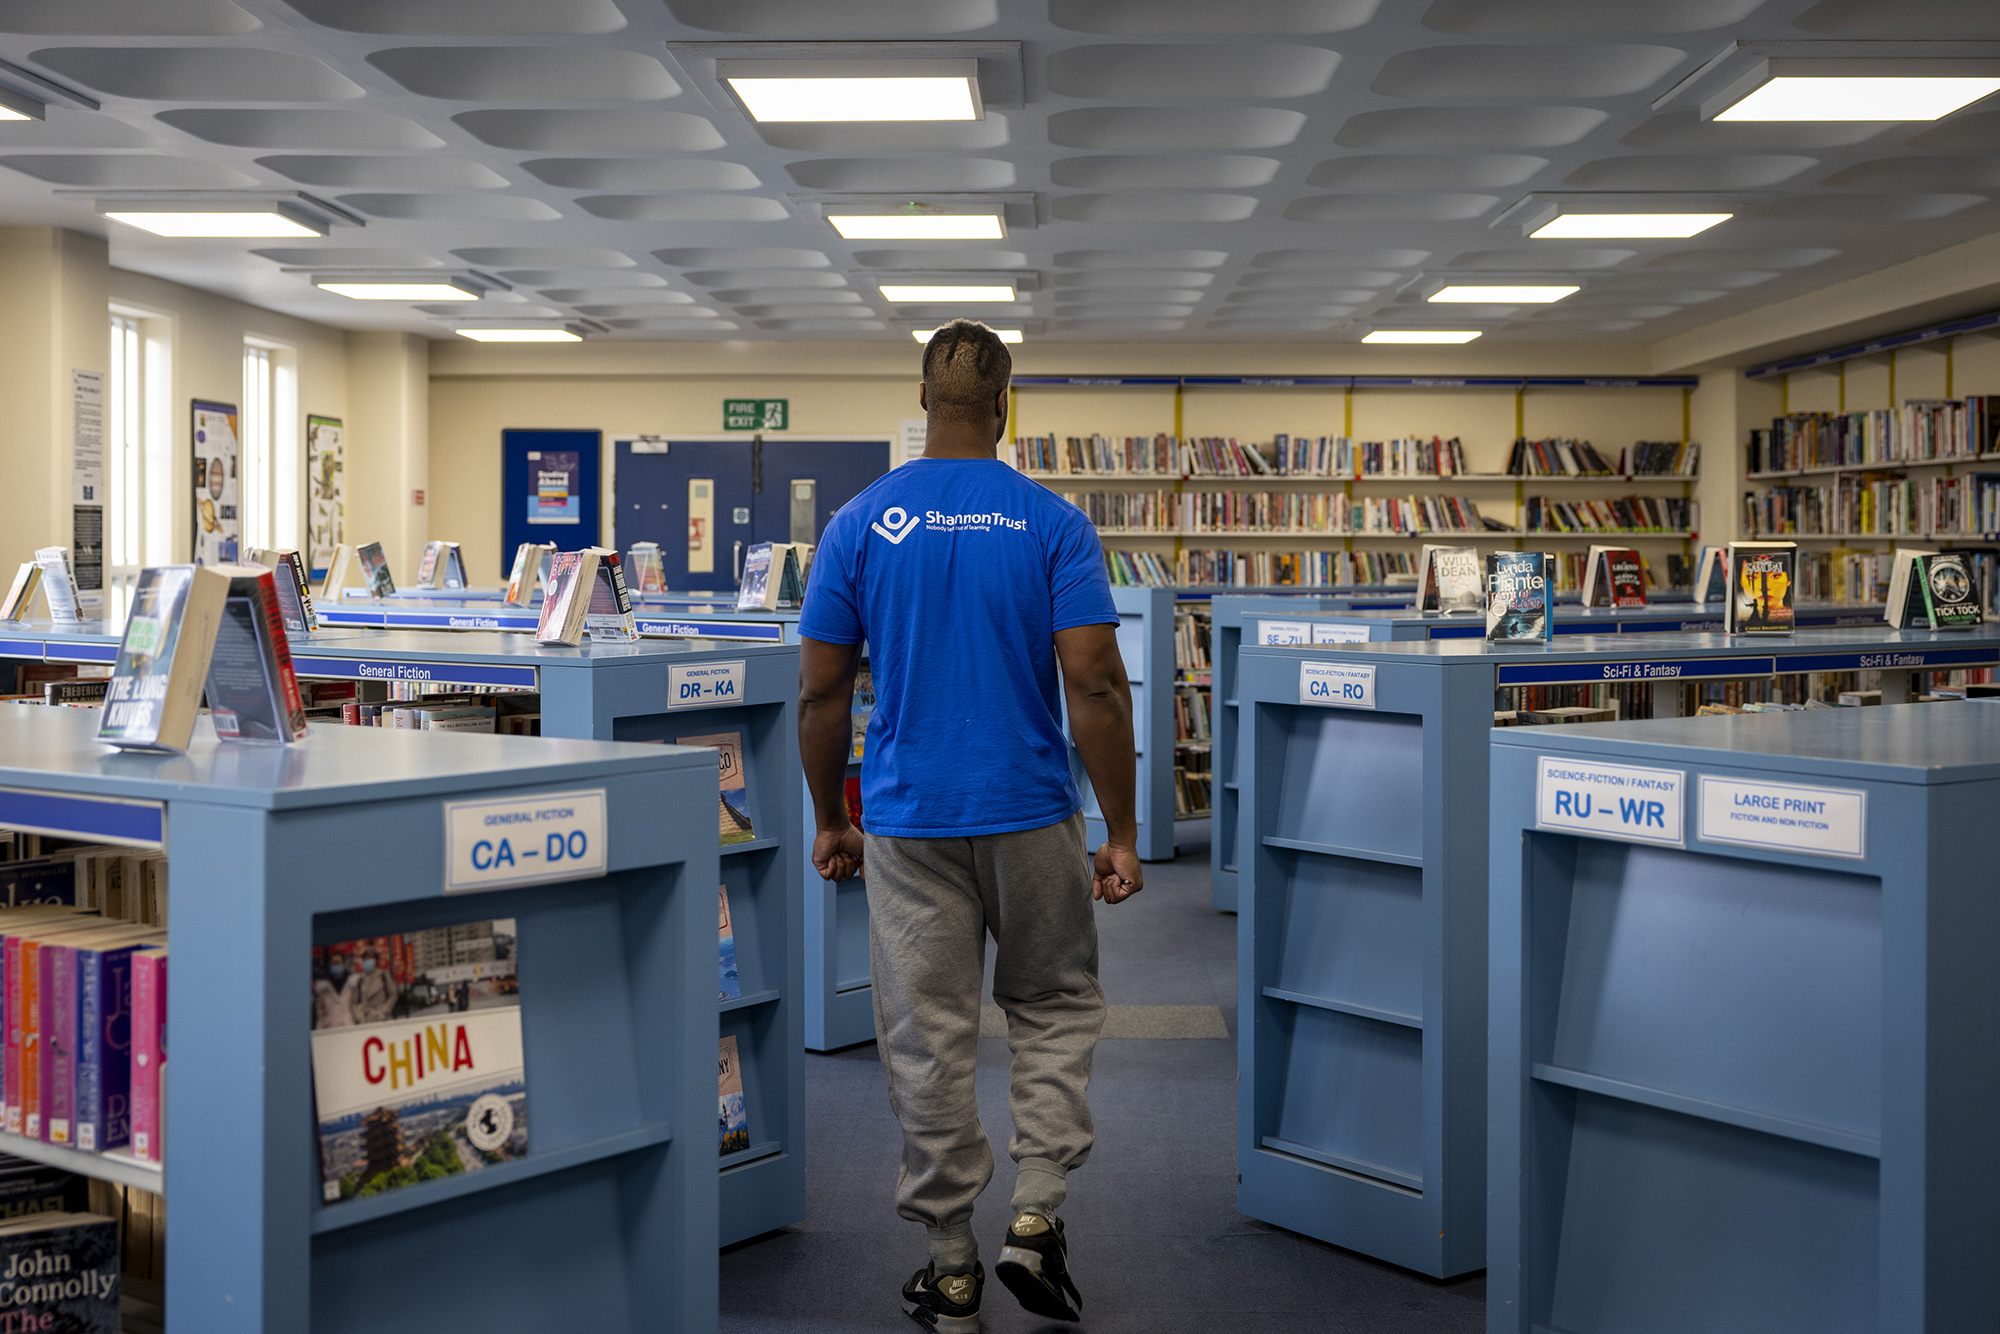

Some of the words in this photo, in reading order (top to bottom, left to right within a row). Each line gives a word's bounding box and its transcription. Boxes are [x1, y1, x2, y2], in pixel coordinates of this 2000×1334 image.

[729, 403, 755, 414] FIRE
[729, 416, 754, 427] EXIT
[1442, 556, 1473, 566] WILL
[1497, 560, 1534, 576] Lynda
[1744, 561, 1784, 574] SAMURAI
[1441, 566, 1476, 577] DEAN
[1489, 574, 1543, 592] Plante
[1489, 591, 1518, 601] TASTE
[1519, 590, 1532, 600] OF
[1510, 599, 1542, 609] BLOOD
[1935, 607, 1956, 617] TICK
[1956, 605, 1980, 615] TOCK
[450, 616, 475, 626] General
[476, 618, 498, 627] Fiction
[642, 622, 671, 634] General
[673, 624, 699, 635] Fiction
[1267, 634, 1279, 645] SE
[1860, 656, 1884, 667] Sci-Fi
[1885, 655, 1892, 665] &
[1893, 654, 1925, 666] Fantasy
[359, 663, 395, 678] General
[398, 666, 430, 680] Fiction
[1305, 668, 1345, 677] SCIENCE-FICTION
[1603, 666, 1632, 678] Sci-Fi
[1634, 666, 1642, 676] &
[1644, 664, 1682, 678] Fantasy
[62, 686, 105, 697] FREDERICK
[110, 677, 134, 701] THE
[132, 674, 168, 700] LONG
[680, 683, 701, 699] DR
[715, 680, 735, 696] KA
[1310, 681, 1330, 697] CA
[1344, 684, 1364, 699] RO
[107, 702, 153, 727] KNIVES
[1547, 769, 1625, 786] SCIENCE-FICTION
[1632, 778, 1675, 792] FANTASY
[1555, 790, 1592, 818] RU
[1620, 798, 1665, 828] WR
[1734, 793, 1780, 810] LARGE
[1784, 799, 1826, 815] PRINT
[484, 814, 533, 826] GENERAL
[536, 808, 574, 821] FICTION
[1730, 812, 1760, 822] FICTION
[1762, 815, 1778, 824] AND
[1779, 817, 1796, 826] NON
[1798, 819, 1830, 830] FICTION
[471, 837, 515, 870] CA
[546, 829, 587, 862] DO
[363, 1024, 474, 1090] CHINA
[1021, 1215, 1036, 1223] NIKE
[4, 1250, 71, 1279] John
[0, 1269, 117, 1308] Connolly
[952, 1279, 967, 1288] NIKE
[0, 1308, 54, 1334] The
